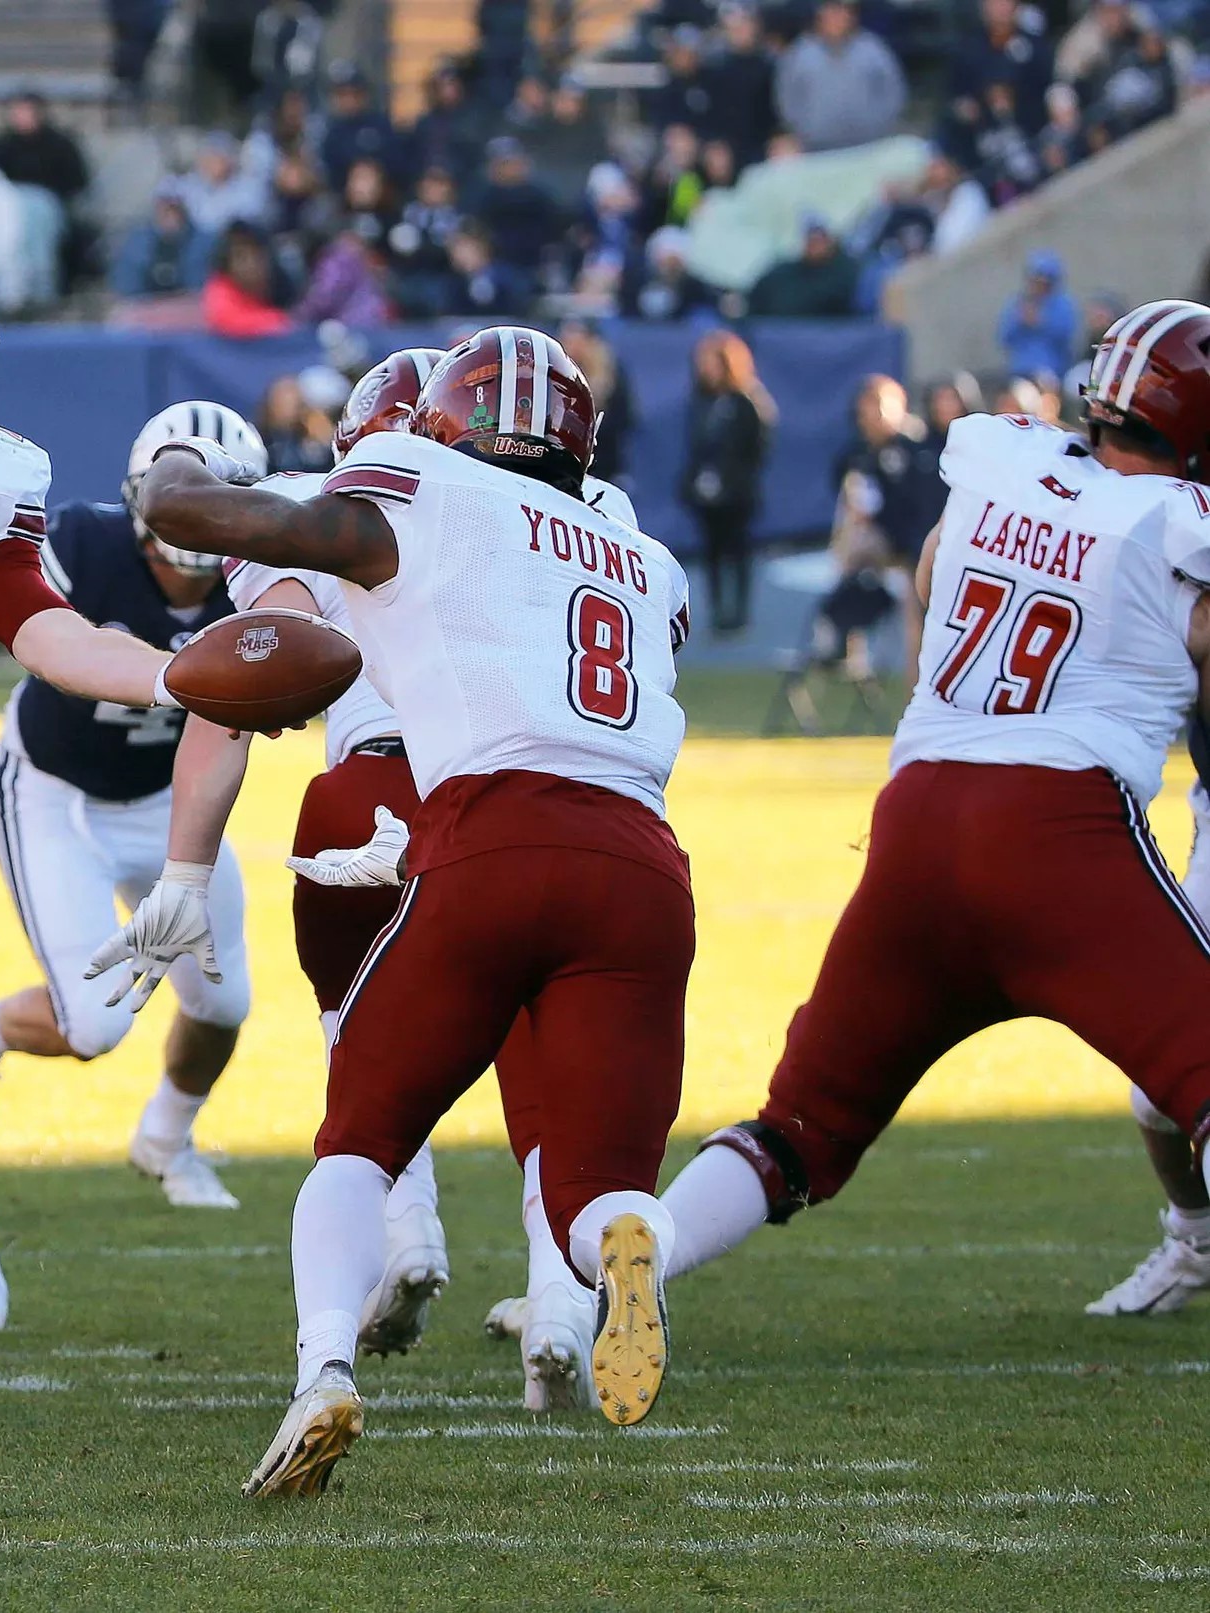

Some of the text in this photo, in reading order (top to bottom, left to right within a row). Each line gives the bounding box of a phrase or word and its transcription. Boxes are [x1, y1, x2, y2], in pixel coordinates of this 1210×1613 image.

[475, 385, 484, 404] 8
[520, 504, 647, 596] YOUNG
[971, 500, 1096, 582] LARGAY
[567, 584, 639, 731] 8
[929, 566, 1084, 715] 79
